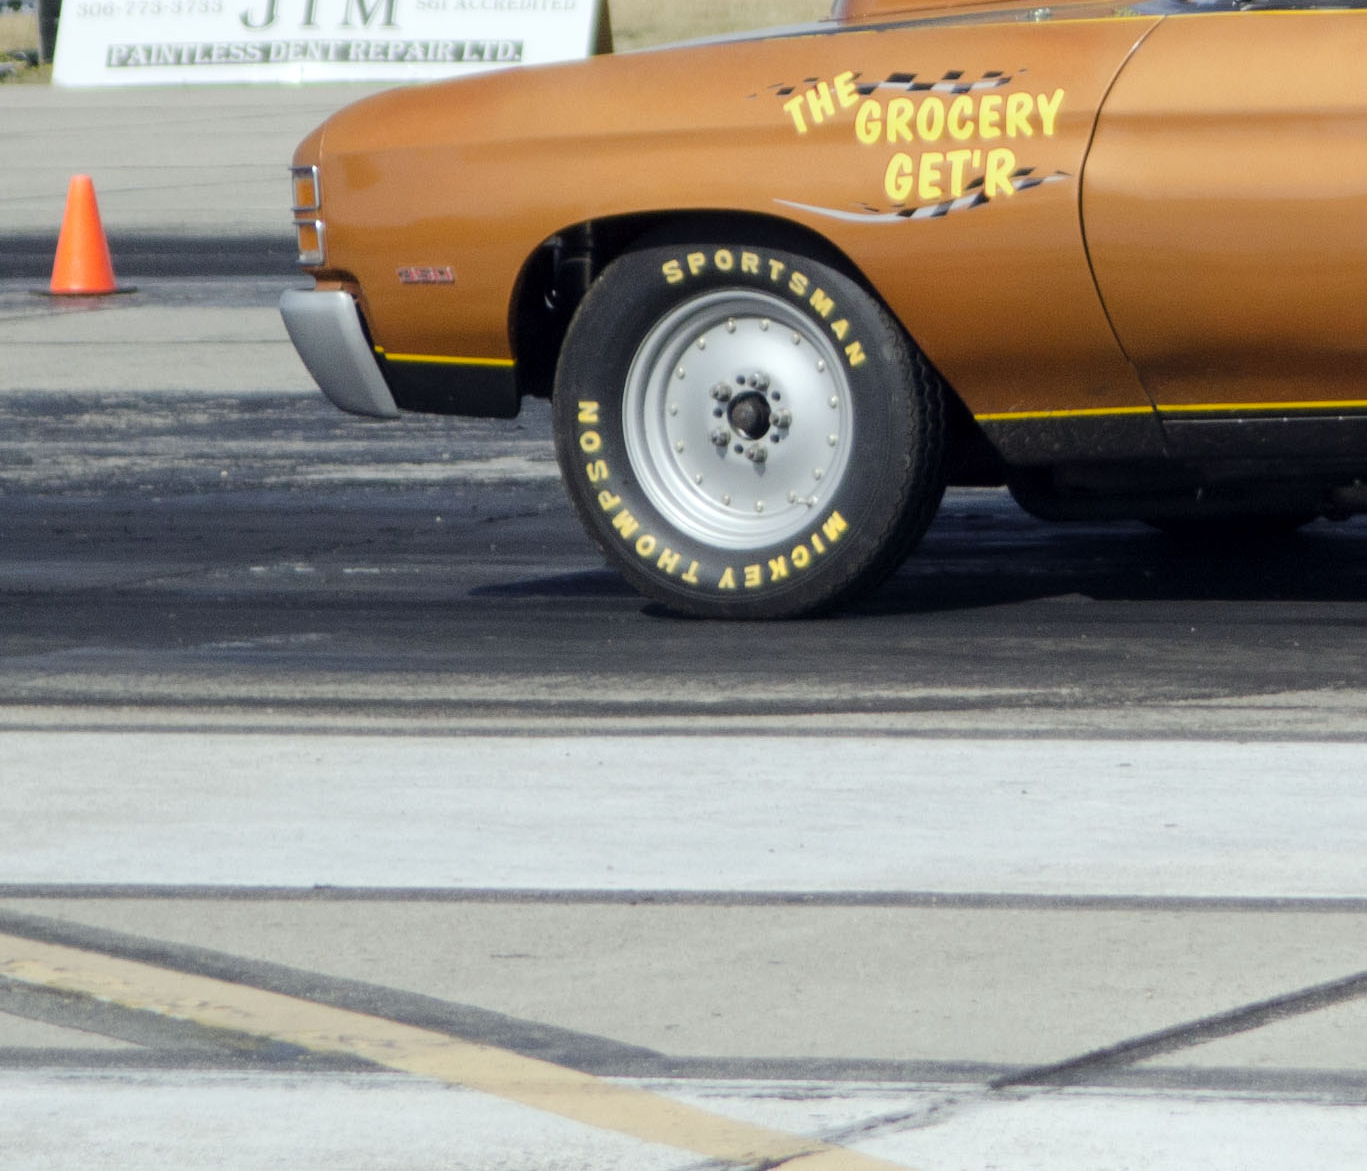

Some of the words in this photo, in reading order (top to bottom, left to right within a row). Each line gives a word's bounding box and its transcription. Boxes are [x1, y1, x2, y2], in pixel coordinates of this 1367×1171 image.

[108, 42, 264, 67] PAINTLESS
[268, 40, 343, 64] DENT
[349, 39, 457, 62] REPAIR
[460, 39, 522, 62] LTD.
[782, 70, 860, 134] THE
[854, 88, 1065, 144] GROCERY
[884, 147, 1017, 200] GET'R
[661, 249, 869, 369] SPORTSMAN
[577, 400, 701, 586] THOMPSON
[717, 510, 849, 589] MICKEY
